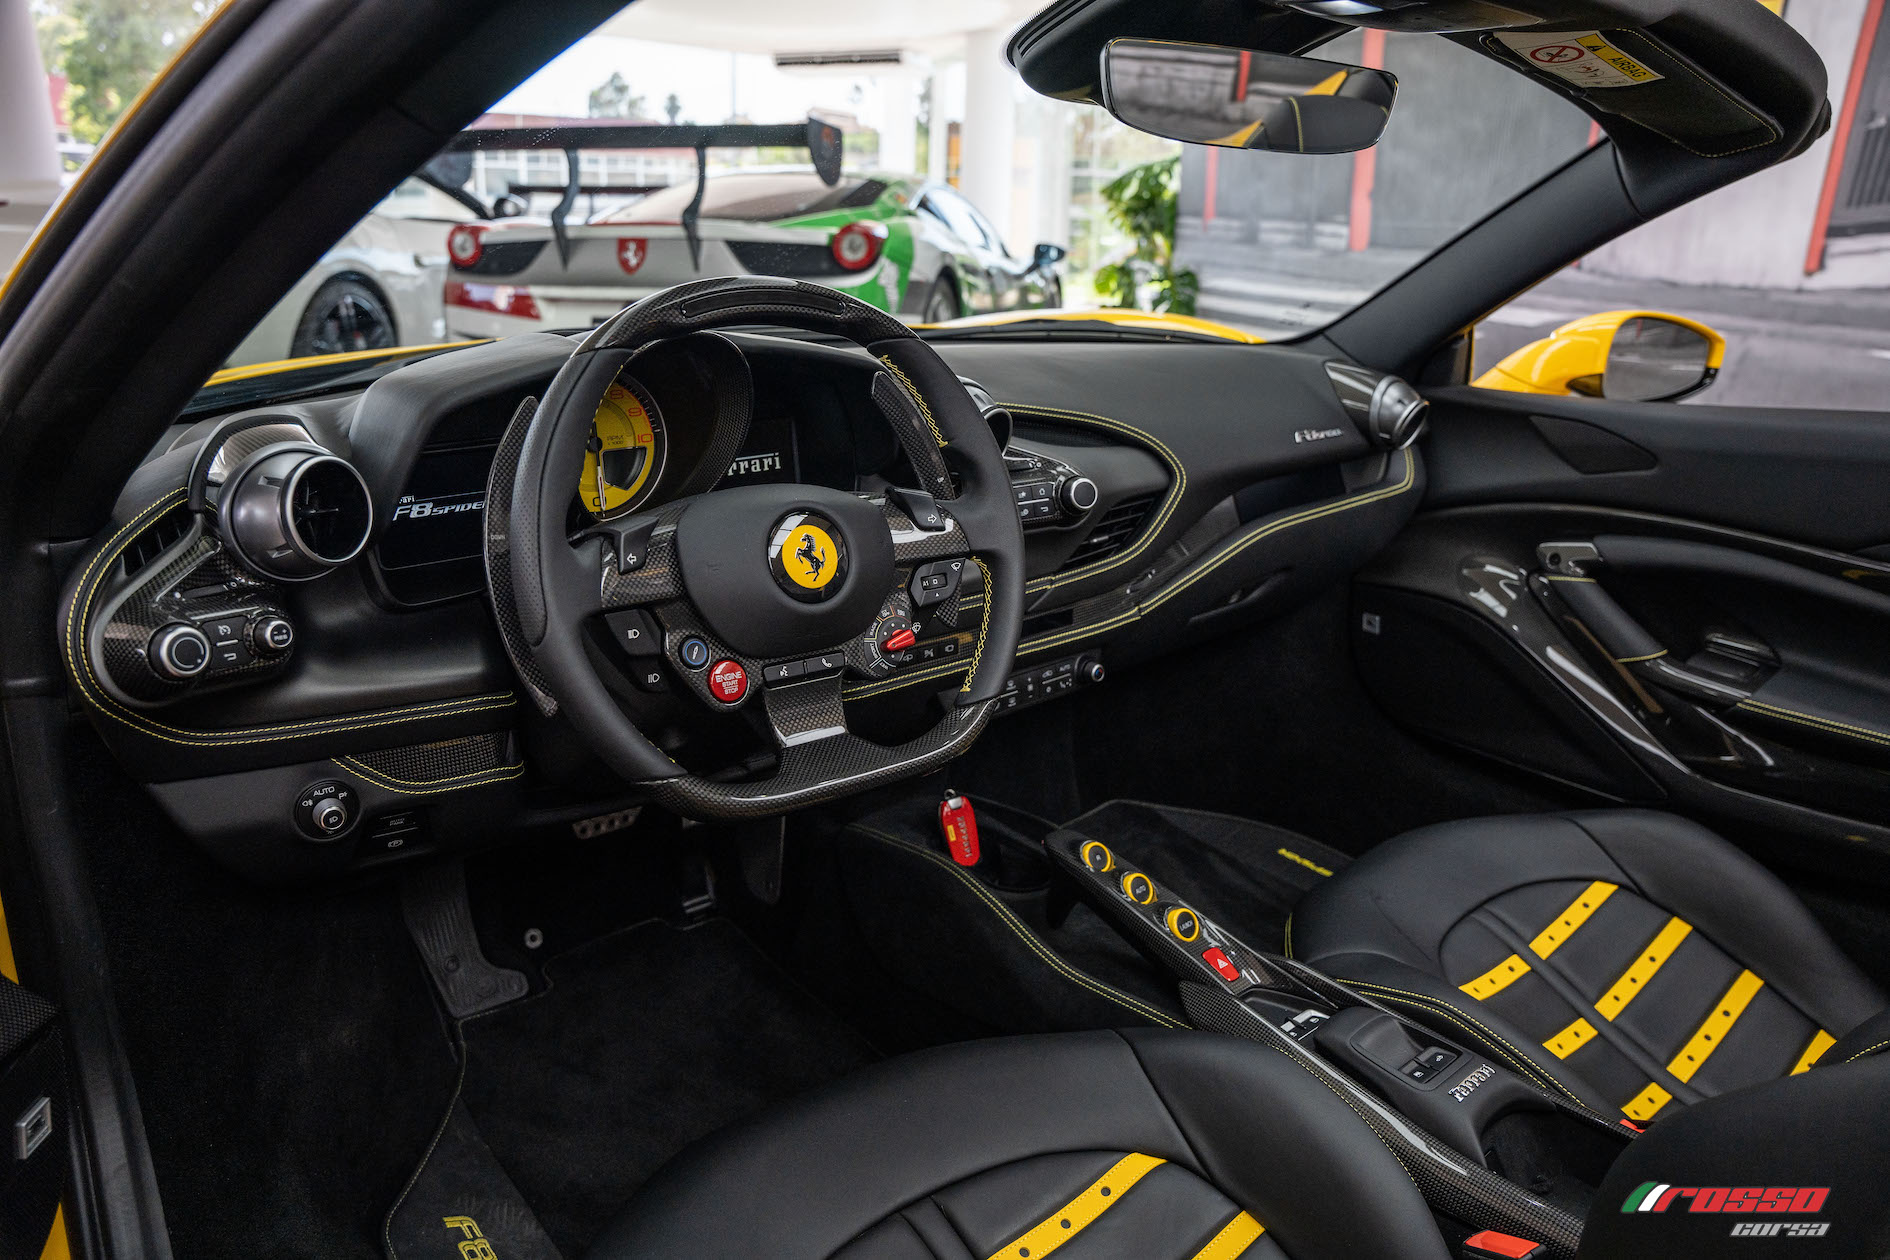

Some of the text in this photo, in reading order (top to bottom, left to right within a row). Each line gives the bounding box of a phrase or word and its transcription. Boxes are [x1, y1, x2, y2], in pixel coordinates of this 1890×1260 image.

[1608, 57, 1647, 78] AIRBAG
[628, 407, 642, 416] 9
[637, 433, 653, 443] 10
[728, 452, 781, 476] rrari
[715, 670, 742, 683] ENGINE
[722, 680, 738, 688] START
[724, 687, 739, 695] STOP
[313, 786, 336, 797] AUTO
[1448, 1064, 1495, 1102] Ferrari
